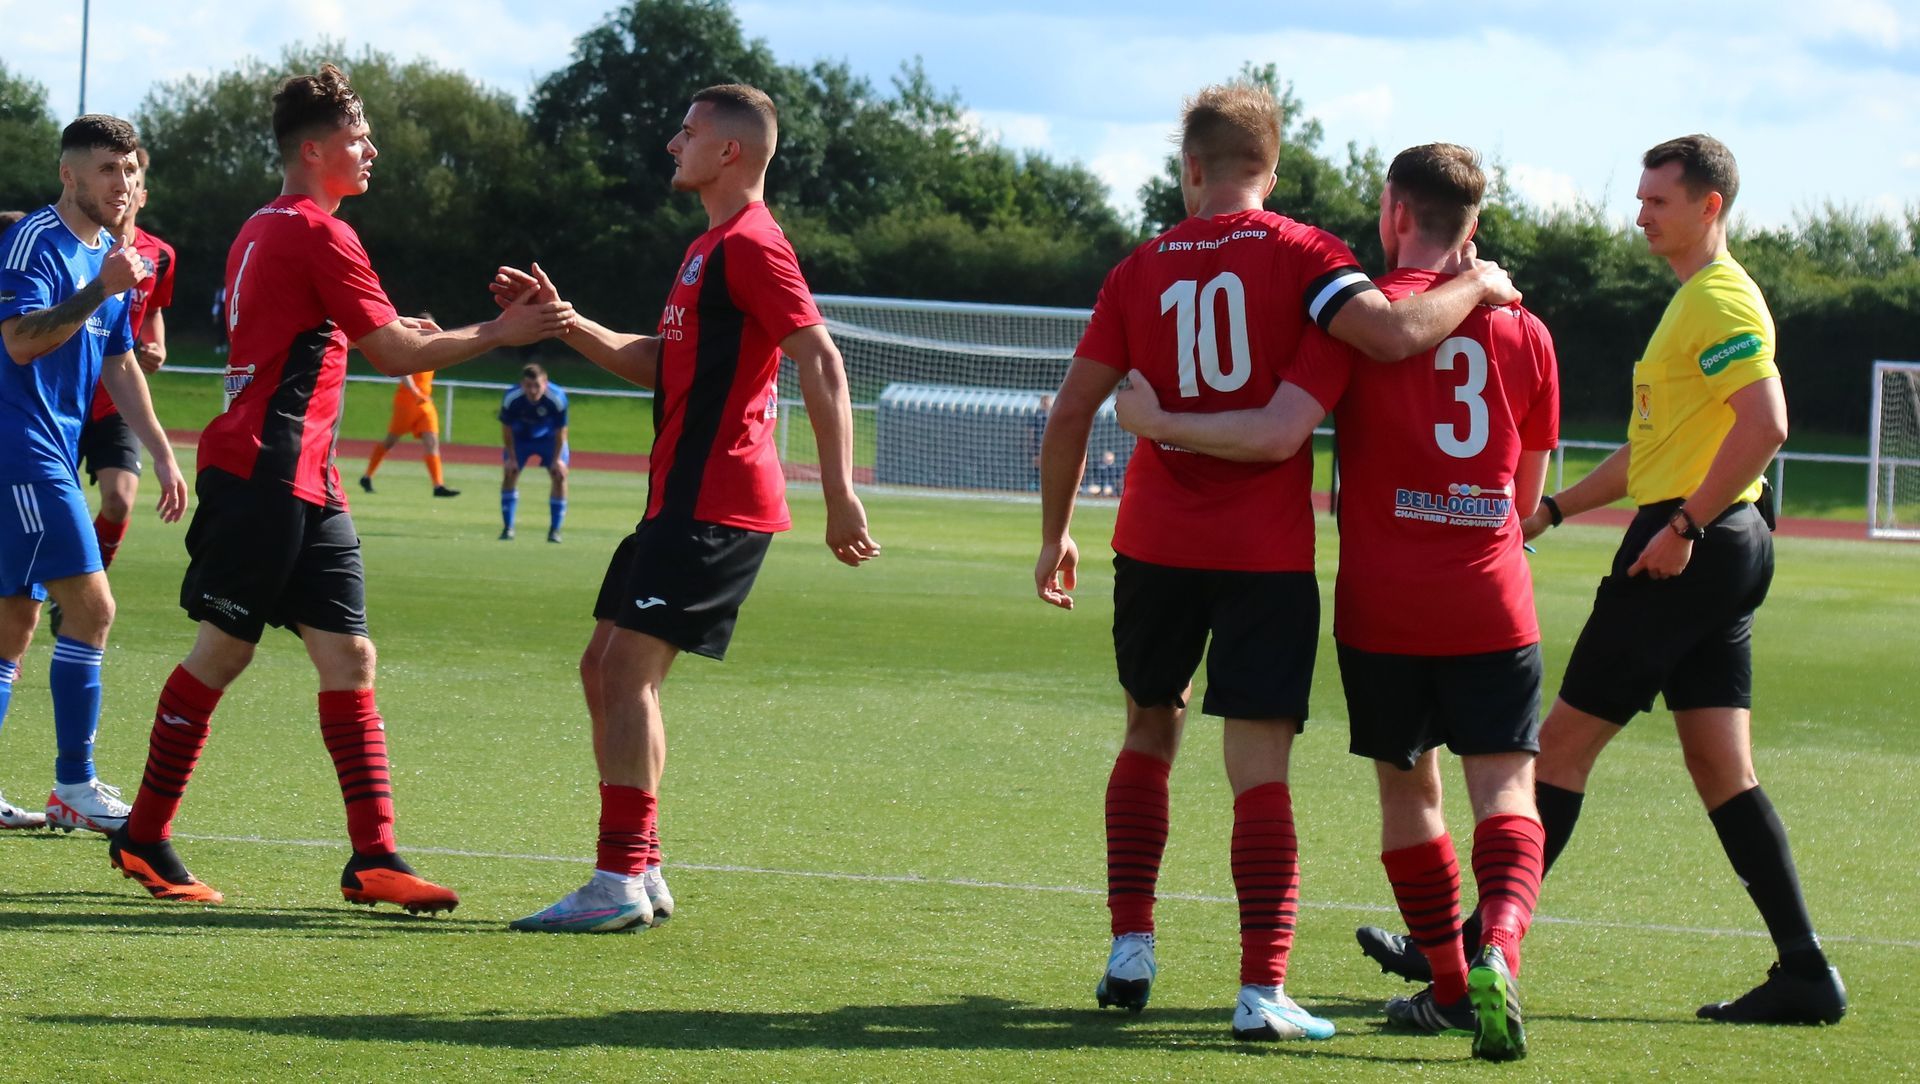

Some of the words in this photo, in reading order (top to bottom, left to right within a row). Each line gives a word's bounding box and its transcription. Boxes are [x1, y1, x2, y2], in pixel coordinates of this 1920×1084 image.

[1168, 241, 1194, 251] BSW
[1232, 229, 1268, 240] Group
[667, 329, 683, 341] LTD
[1160, 271, 1252, 398] 10
[1701, 338, 1758, 369] Specsavers
[1434, 336, 1490, 459] 3
